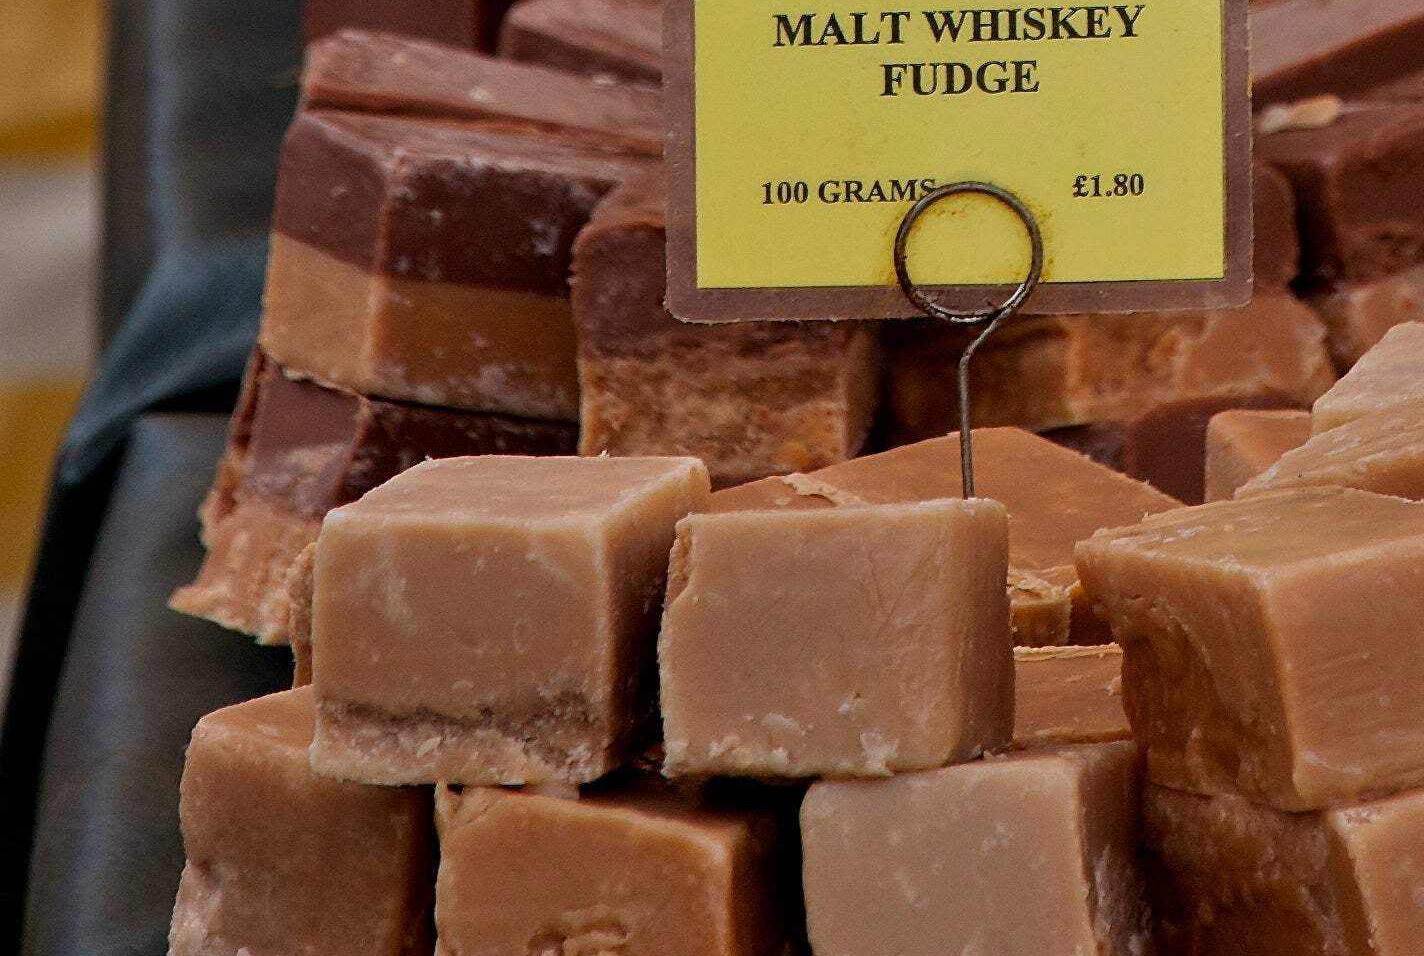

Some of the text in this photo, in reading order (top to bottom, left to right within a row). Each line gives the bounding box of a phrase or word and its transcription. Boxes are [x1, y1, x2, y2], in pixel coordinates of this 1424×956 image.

[772, 4, 1147, 47] MALT WHISKEY
[880, 60, 1040, 96] FUDGE
[762, 181, 808, 205] 100
[1072, 173, 1145, 198] £1.80
